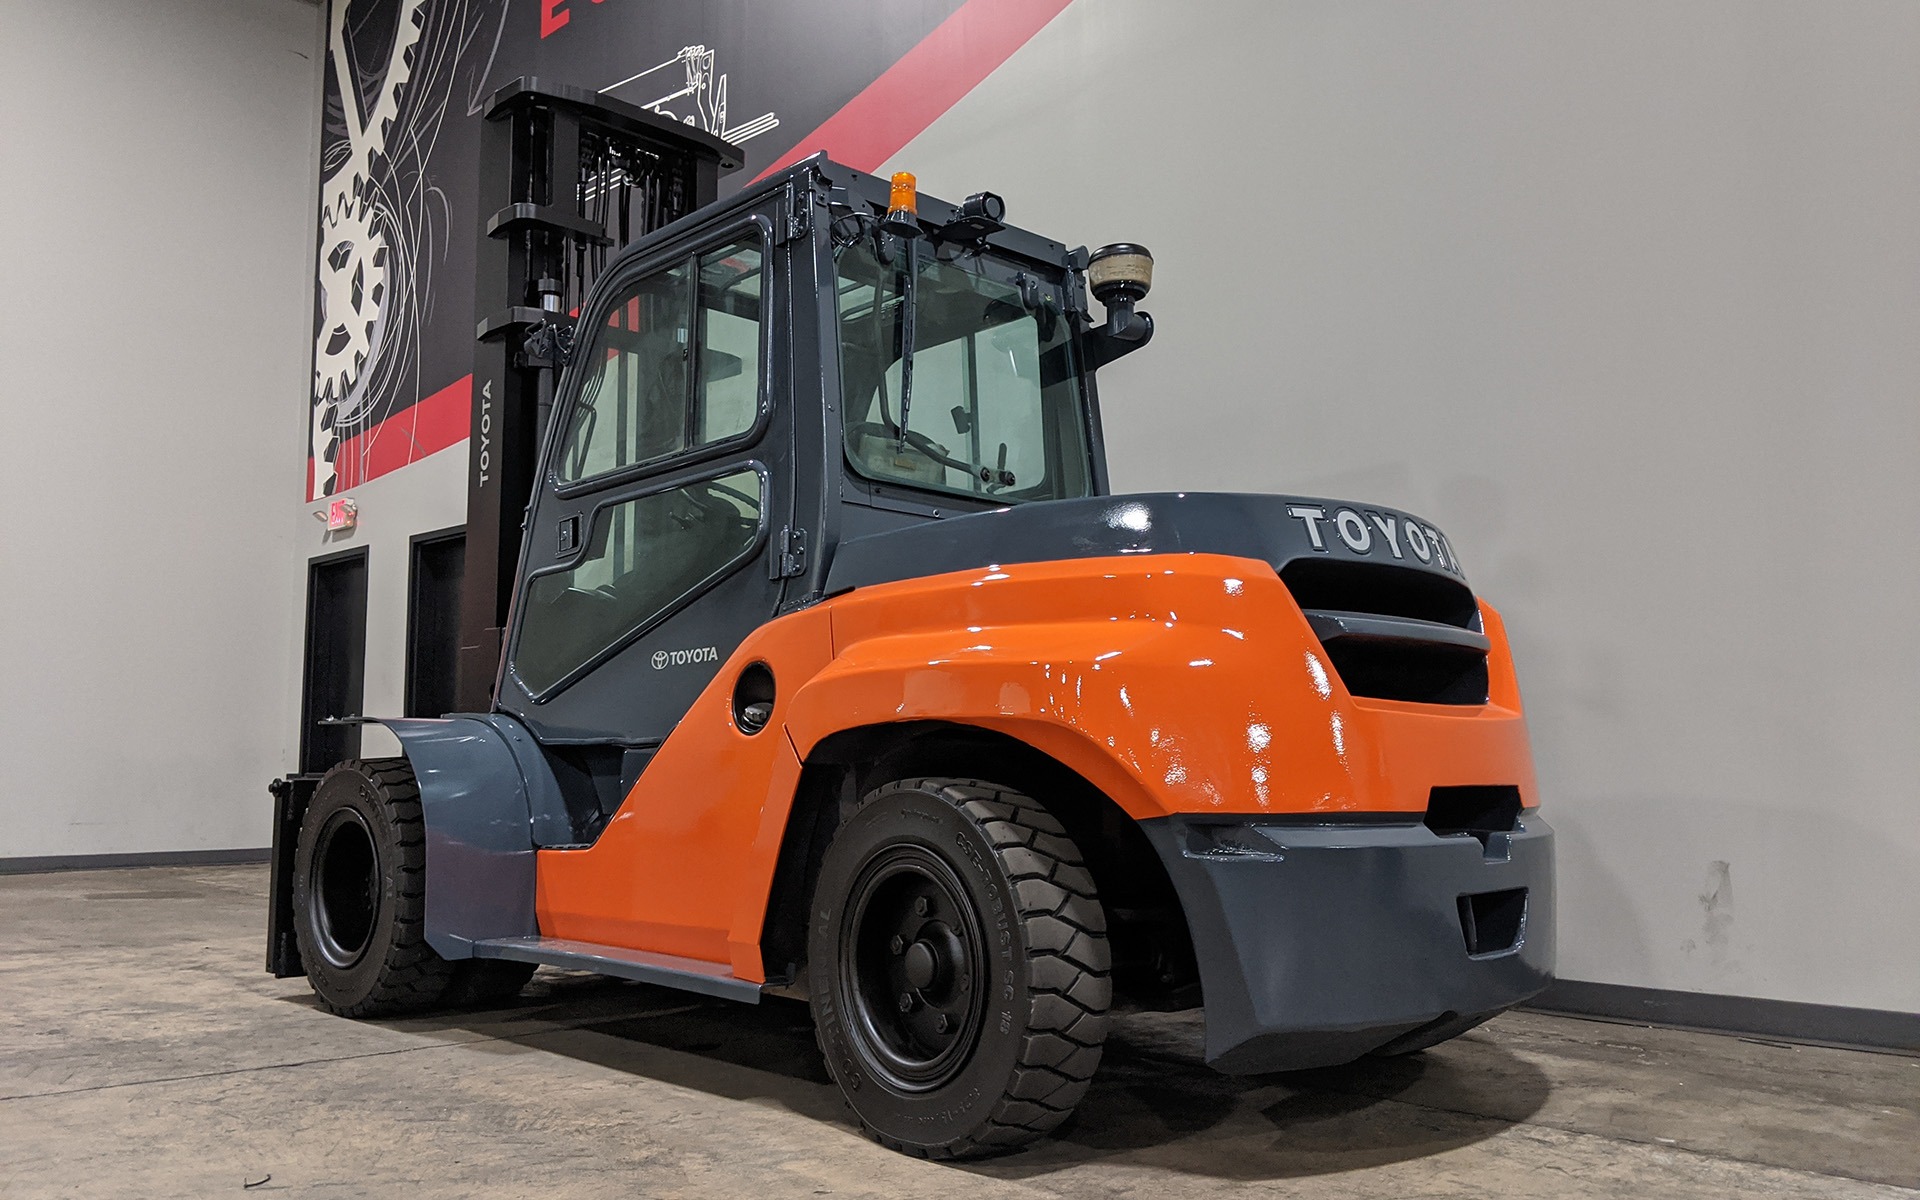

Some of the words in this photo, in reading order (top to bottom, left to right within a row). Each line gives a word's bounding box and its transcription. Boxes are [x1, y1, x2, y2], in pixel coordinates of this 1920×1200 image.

[480, 379, 492, 488] TOYOTA
[1289, 505, 1464, 575] TOYOTA
[670, 647, 718, 665] TOYOTA
